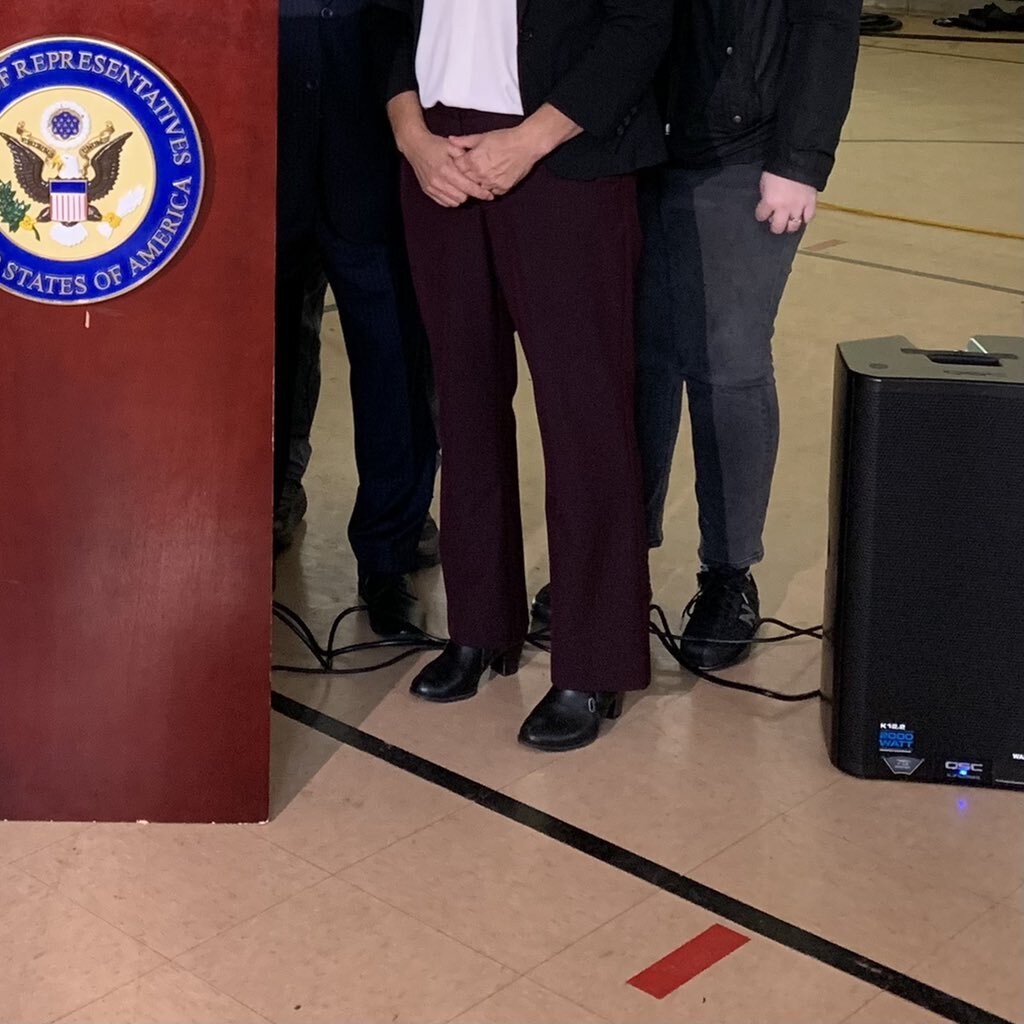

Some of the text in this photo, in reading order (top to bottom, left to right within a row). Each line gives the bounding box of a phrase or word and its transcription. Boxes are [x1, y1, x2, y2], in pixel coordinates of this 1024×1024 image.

[12, 50, 192, 166] REPRESENTATIVES
[2, 262, 88, 296] STATES
[94, 265, 123, 290] OF
[130, 176, 193, 276] AMERICA
[879, 739, 914, 748] WATT
[945, 761, 983, 772] QSC
